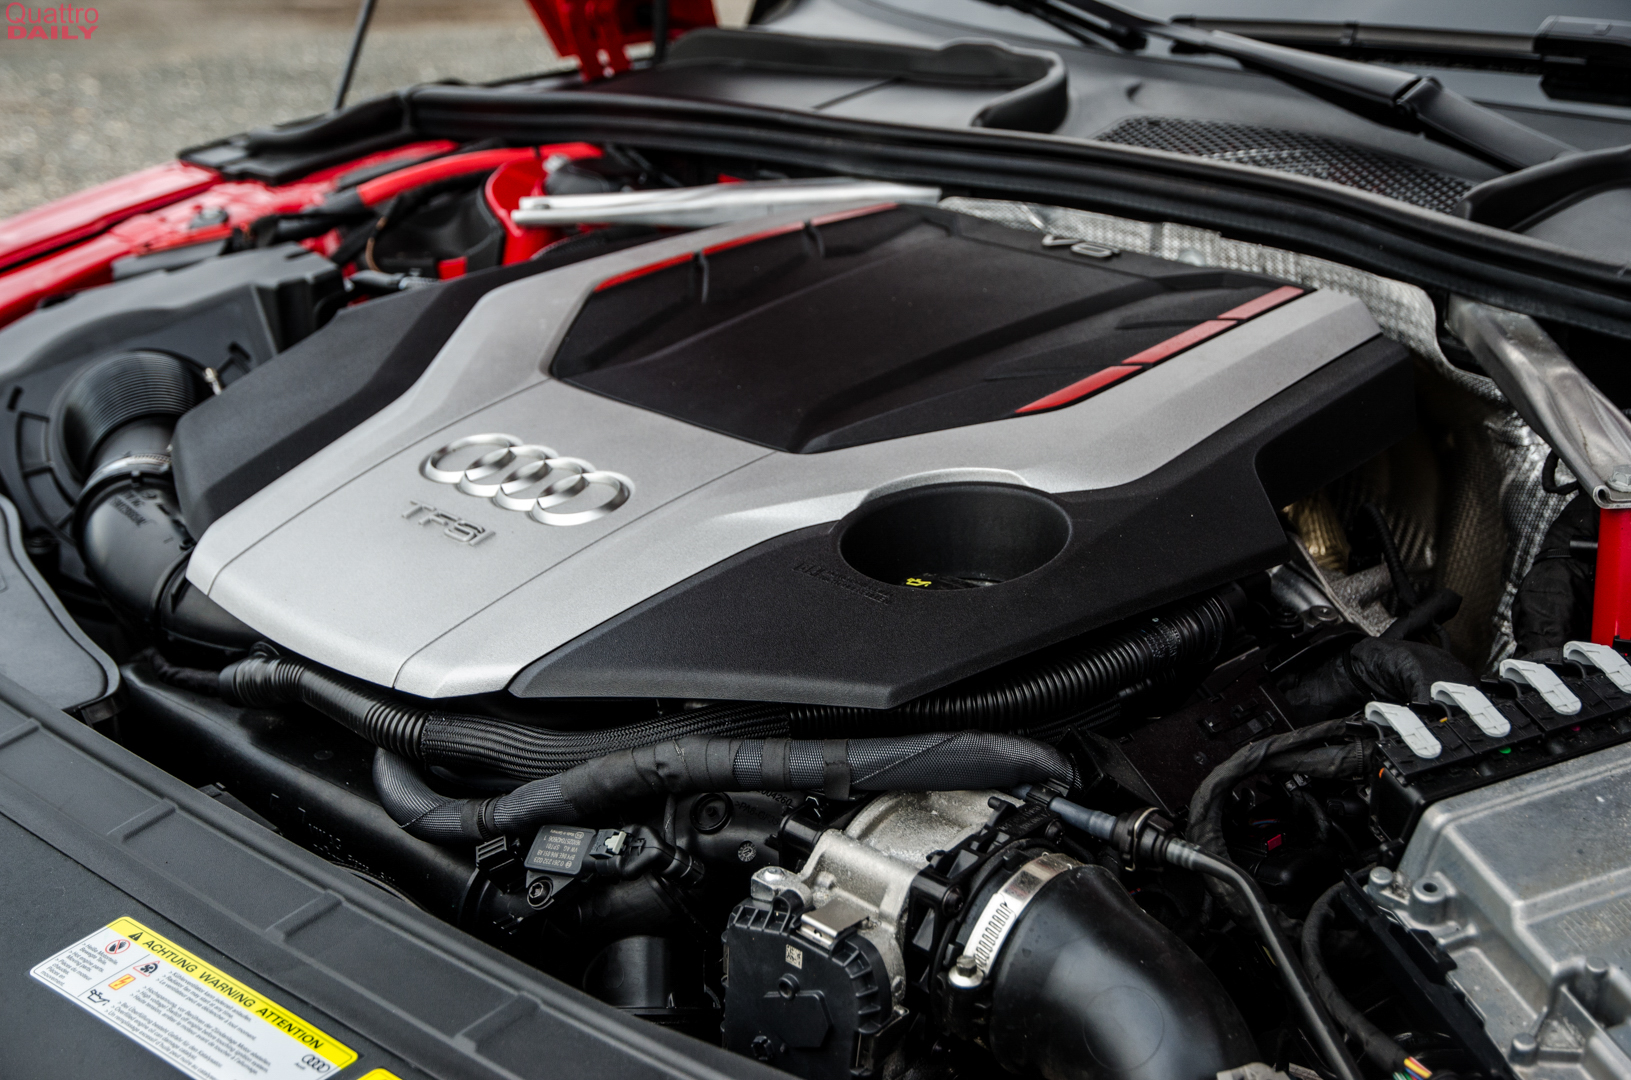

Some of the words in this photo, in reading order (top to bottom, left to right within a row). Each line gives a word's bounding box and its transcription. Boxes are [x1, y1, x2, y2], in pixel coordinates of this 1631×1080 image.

[143, 939, 198, 972] ACHTUNG
[198, 972, 256, 1007] WARNING
[255, 1007, 324, 1049] ATTENTION
